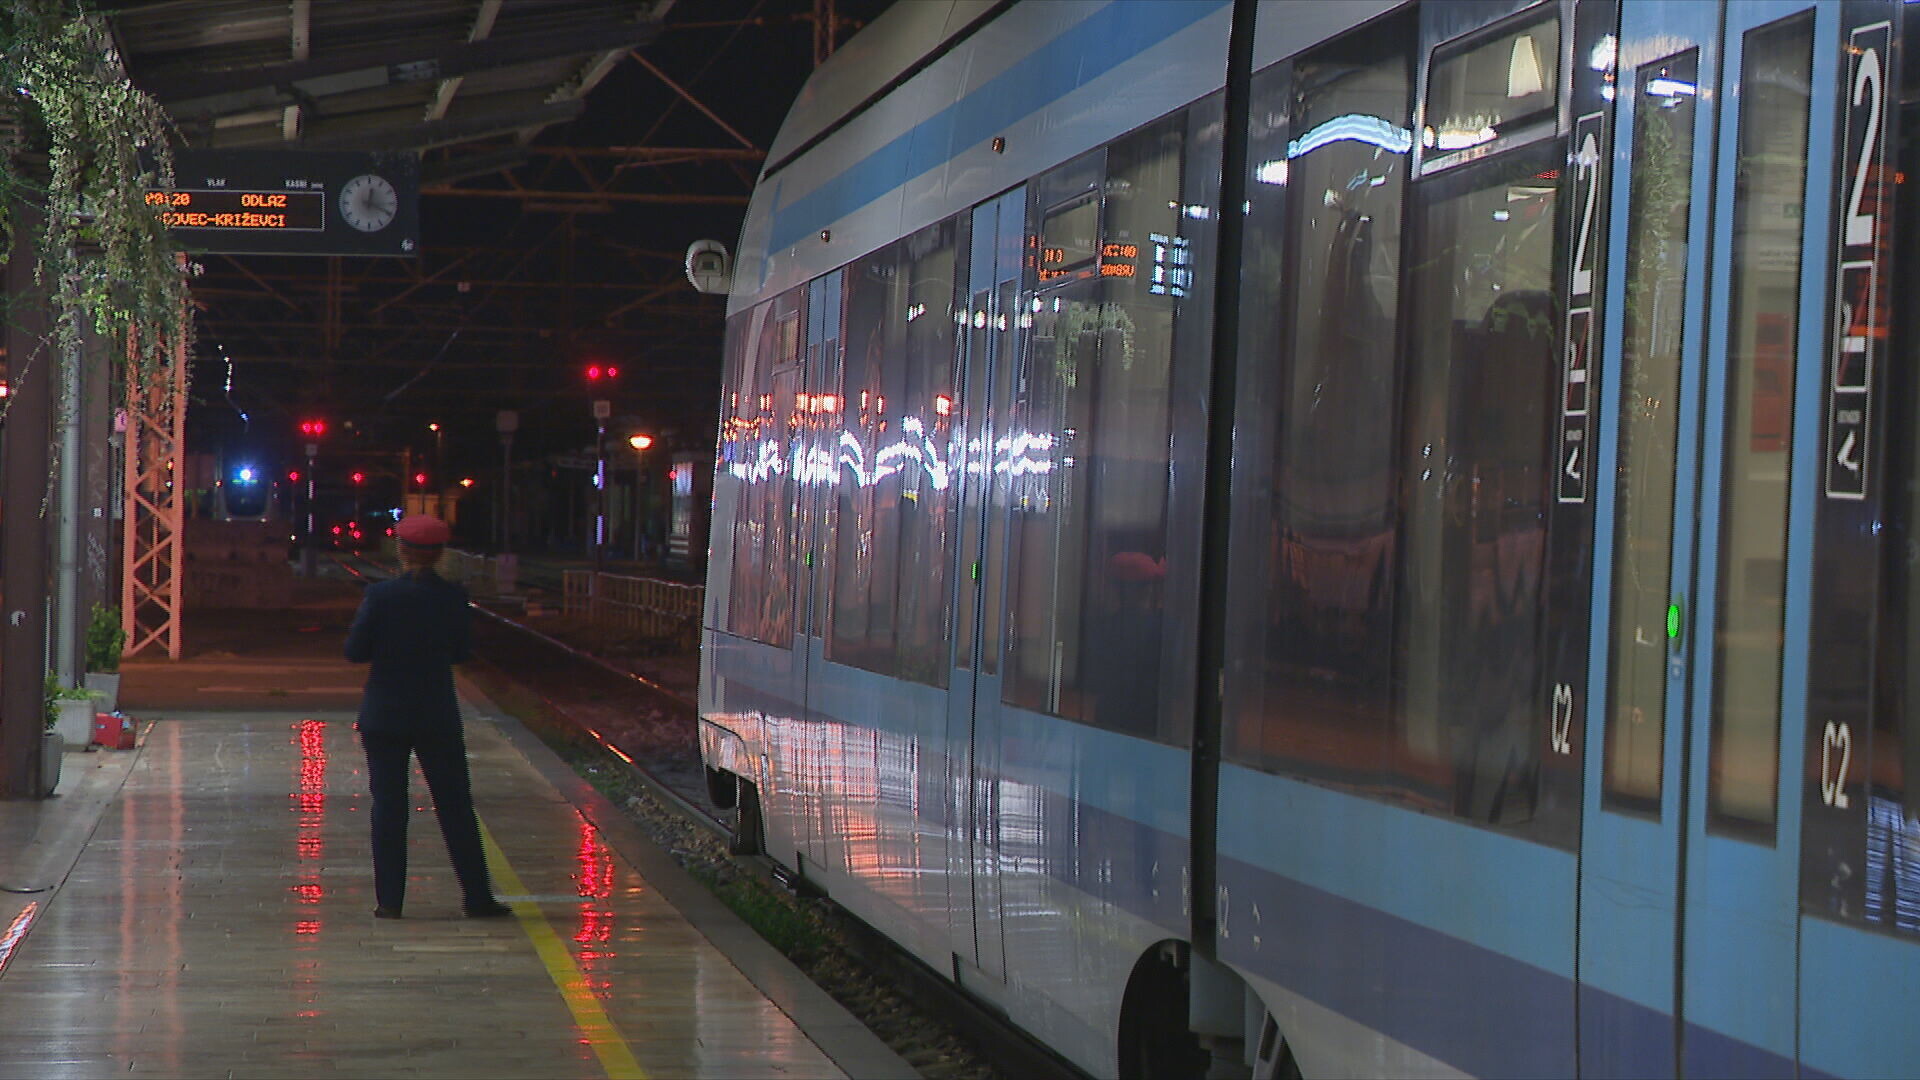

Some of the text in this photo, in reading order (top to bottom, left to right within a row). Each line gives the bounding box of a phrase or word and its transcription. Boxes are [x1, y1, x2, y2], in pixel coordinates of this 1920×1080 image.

[1846, 48, 1881, 246] 2
[241, 194, 287, 207] ODLAZ
[1573, 133, 1597, 296] 2
[1551, 683, 1573, 754] C2
[1822, 720, 1851, 808] C2
